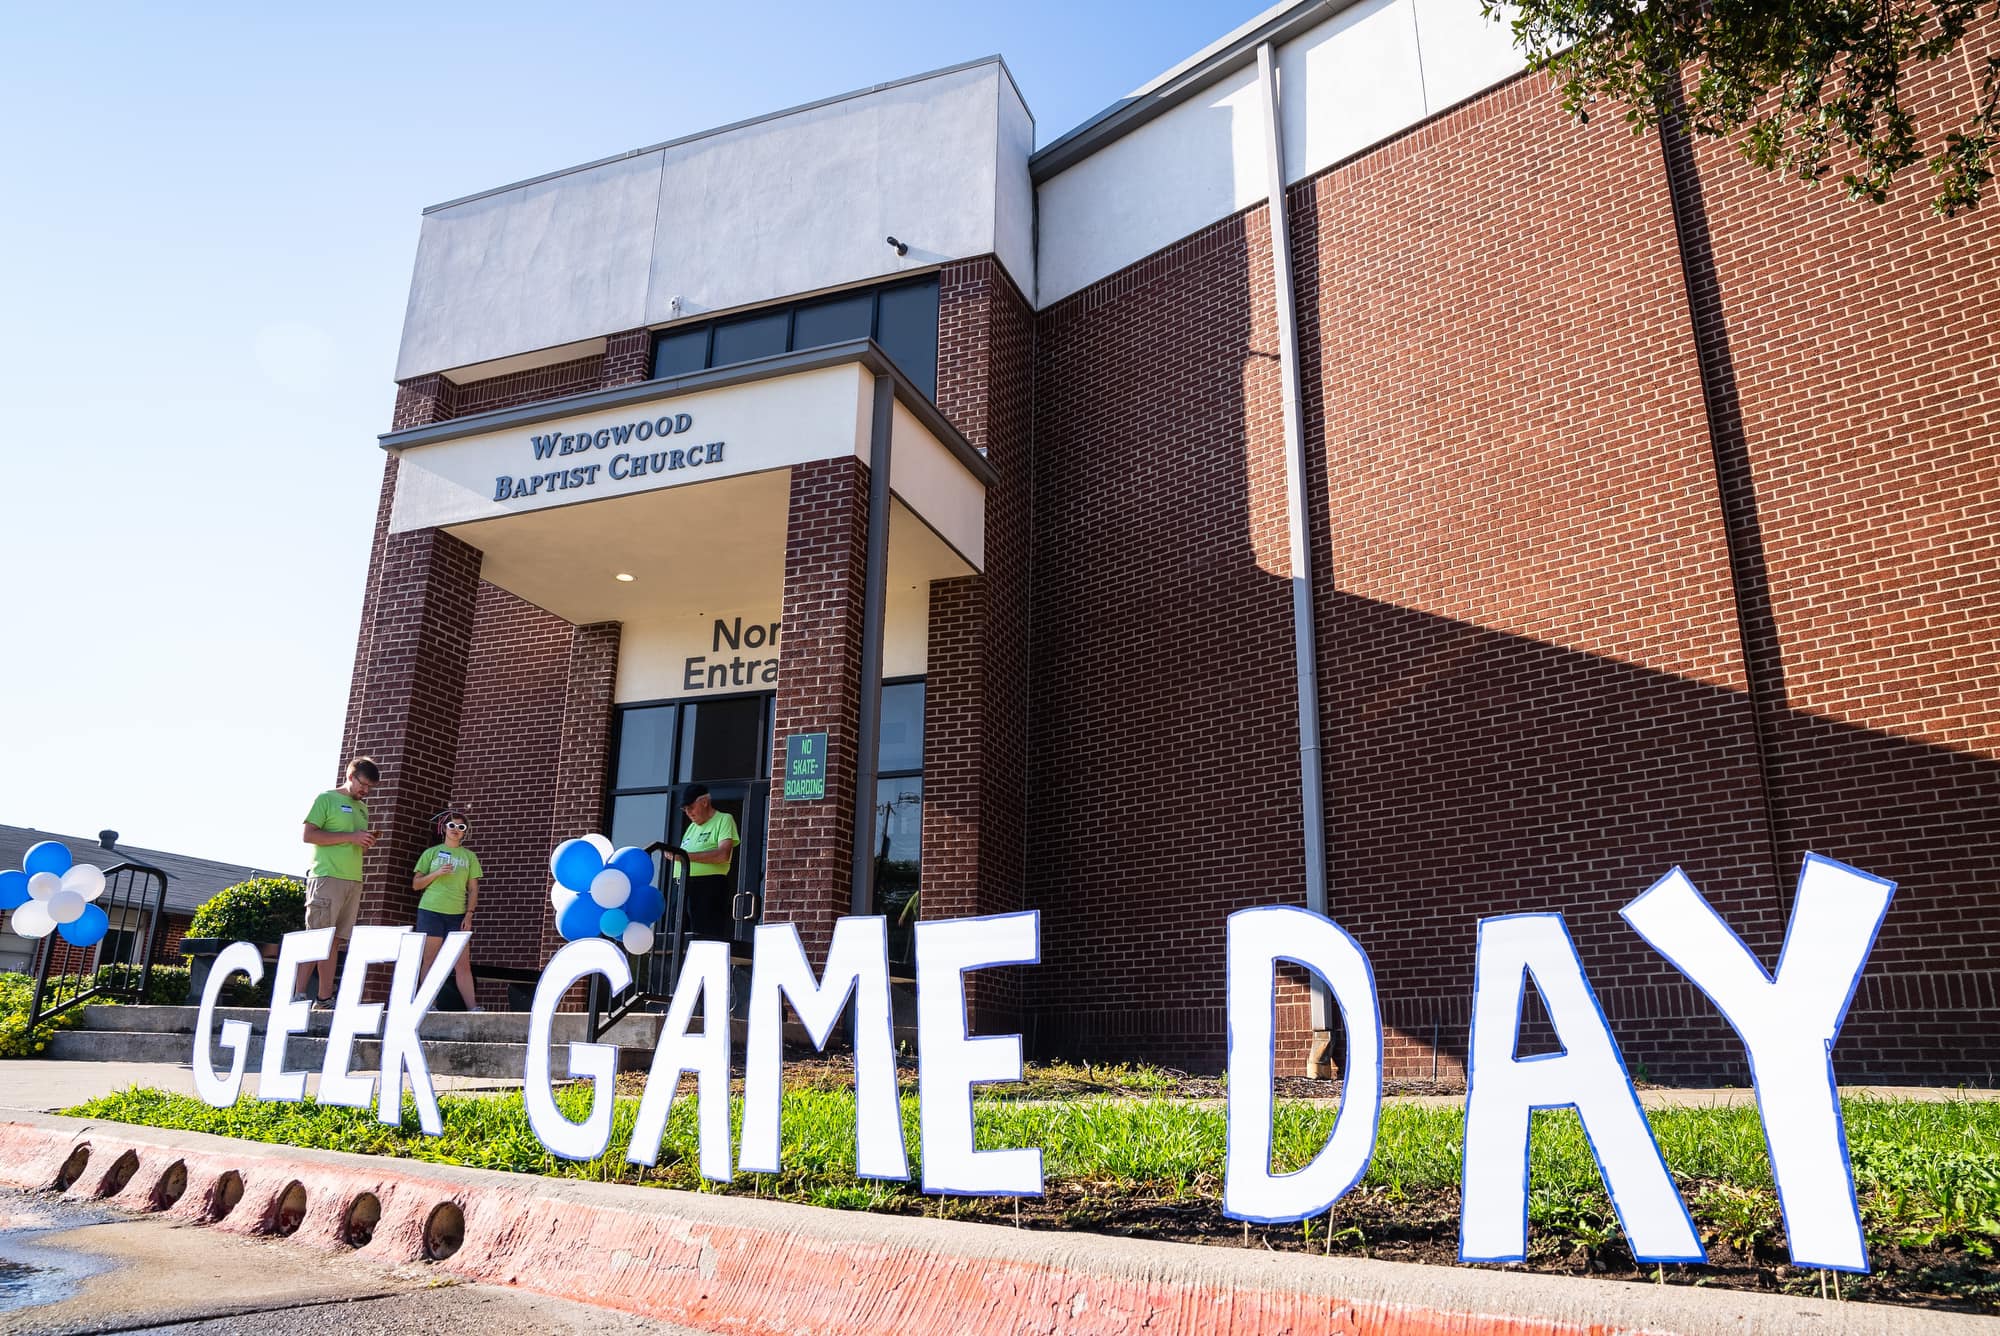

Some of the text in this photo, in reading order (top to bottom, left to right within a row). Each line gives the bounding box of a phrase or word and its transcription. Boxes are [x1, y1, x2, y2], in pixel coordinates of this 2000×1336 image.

[531, 413, 692, 460] WEDGWOOD
[493, 441, 725, 501] BAPTIST CHURCH
[712, 617, 782, 652] Nor
[683, 656, 779, 690] Entra
[801, 739, 812, 755] NO
[792, 759, 819, 775] SKATE-
[785, 778, 823, 796] BOARDING
[192, 850, 1898, 1273] GEEK GAME DAY
